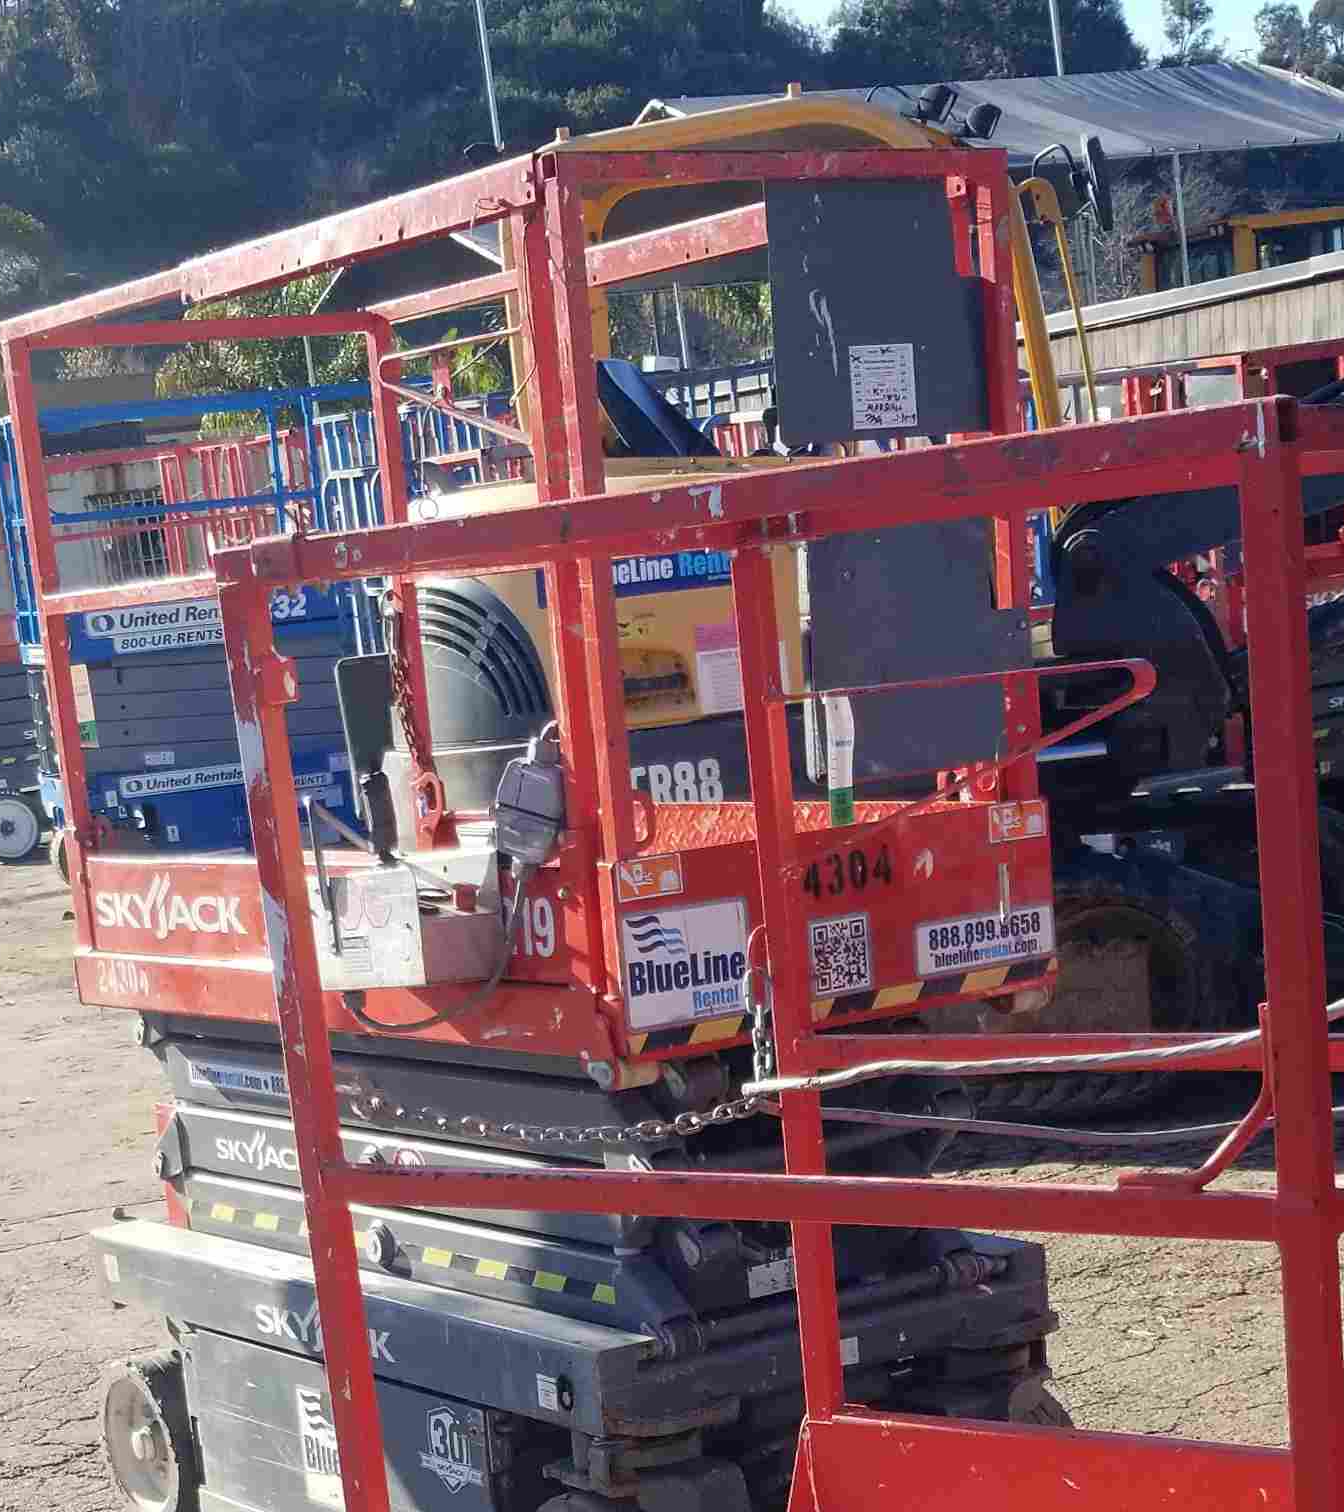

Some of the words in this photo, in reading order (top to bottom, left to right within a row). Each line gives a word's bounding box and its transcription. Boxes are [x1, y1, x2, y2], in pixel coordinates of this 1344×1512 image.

[678, 551, 730, 577] Rent
[119, 606, 180, 630] United
[186, 605, 219, 623] Ren
[120, 628, 224, 650] 800-UR-RENTS
[145, 773, 192, 792] United
[194, 767, 244, 785] Rentals
[95, 871, 249, 940] SKYJACK
[628, 950, 747, 998] BlueLine
[692, 985, 739, 1010] Rental
[215, 1127, 299, 1171] SKYJAC
[255, 1298, 400, 1364] SKYK
